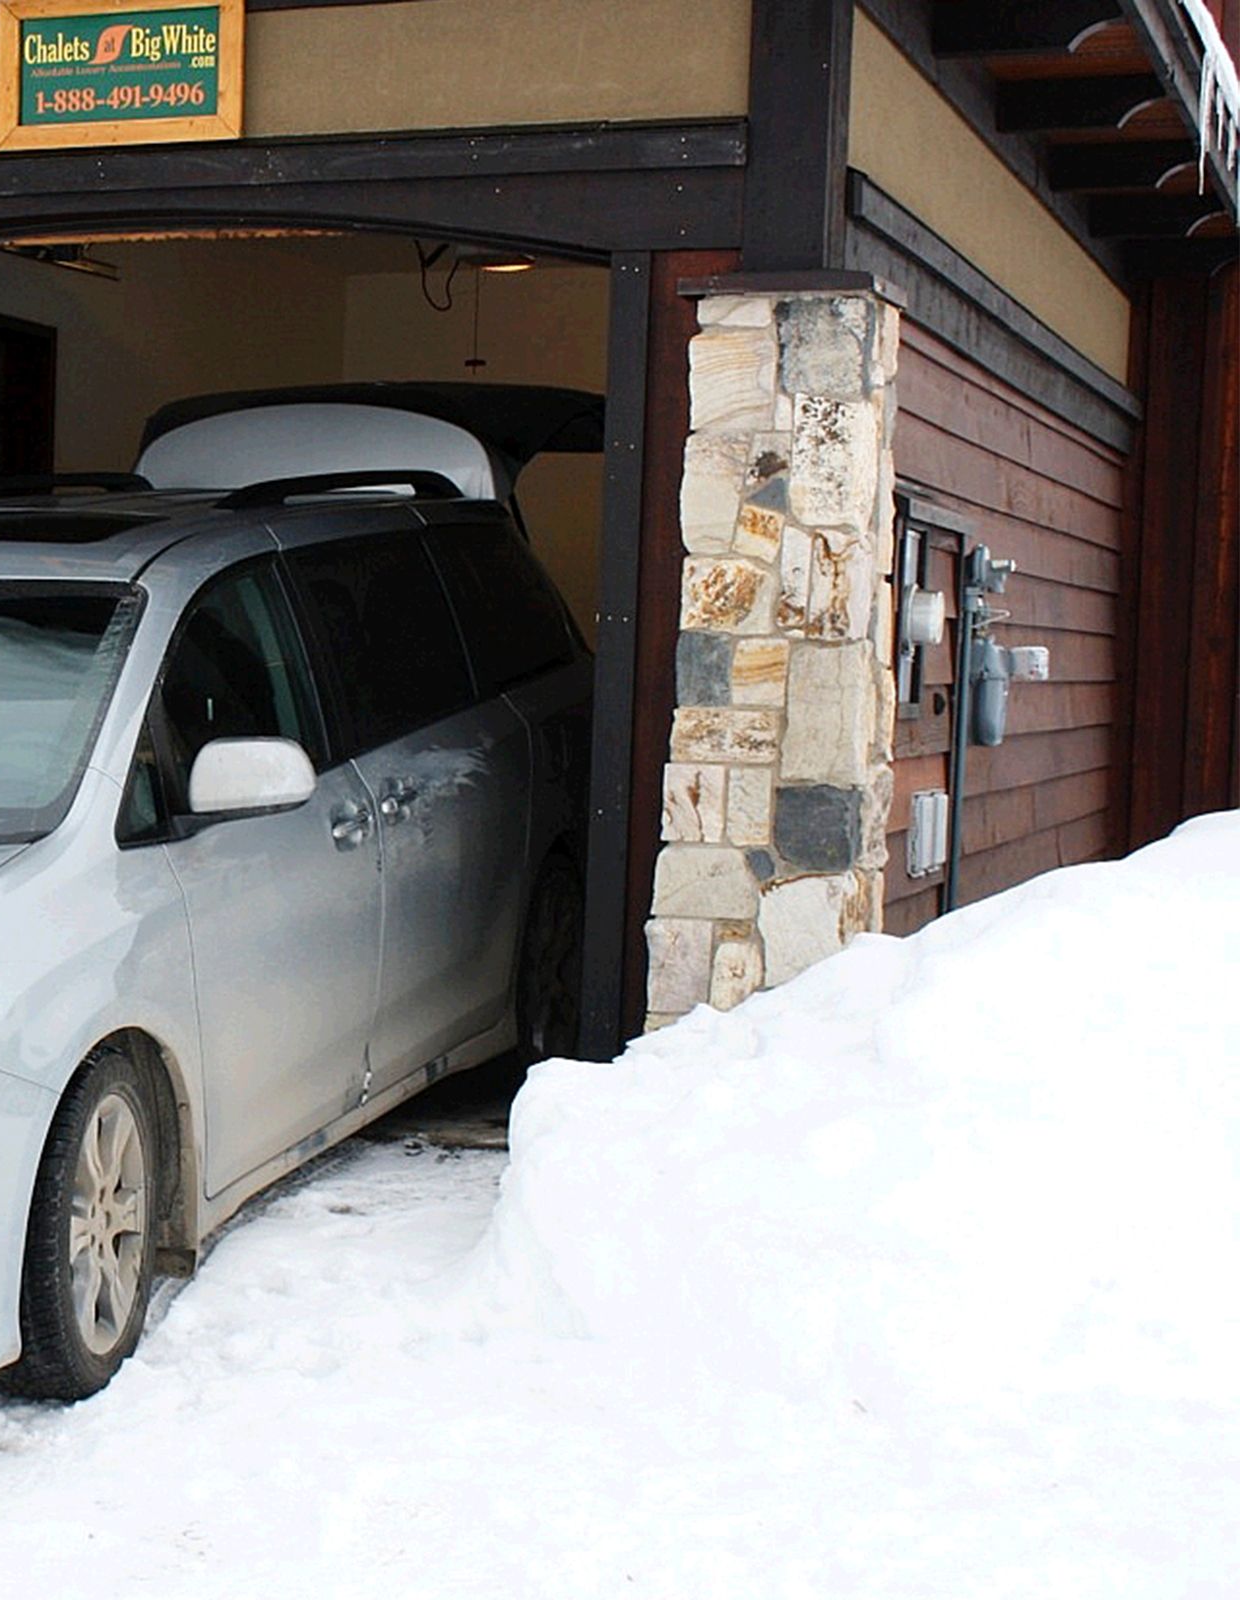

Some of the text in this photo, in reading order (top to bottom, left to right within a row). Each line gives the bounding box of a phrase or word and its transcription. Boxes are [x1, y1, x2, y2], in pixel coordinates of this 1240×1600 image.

[24, 33, 90, 65] Chalets
[103, 38, 116, 53] at
[35, 81, 205, 114] 1-888-491-9496
